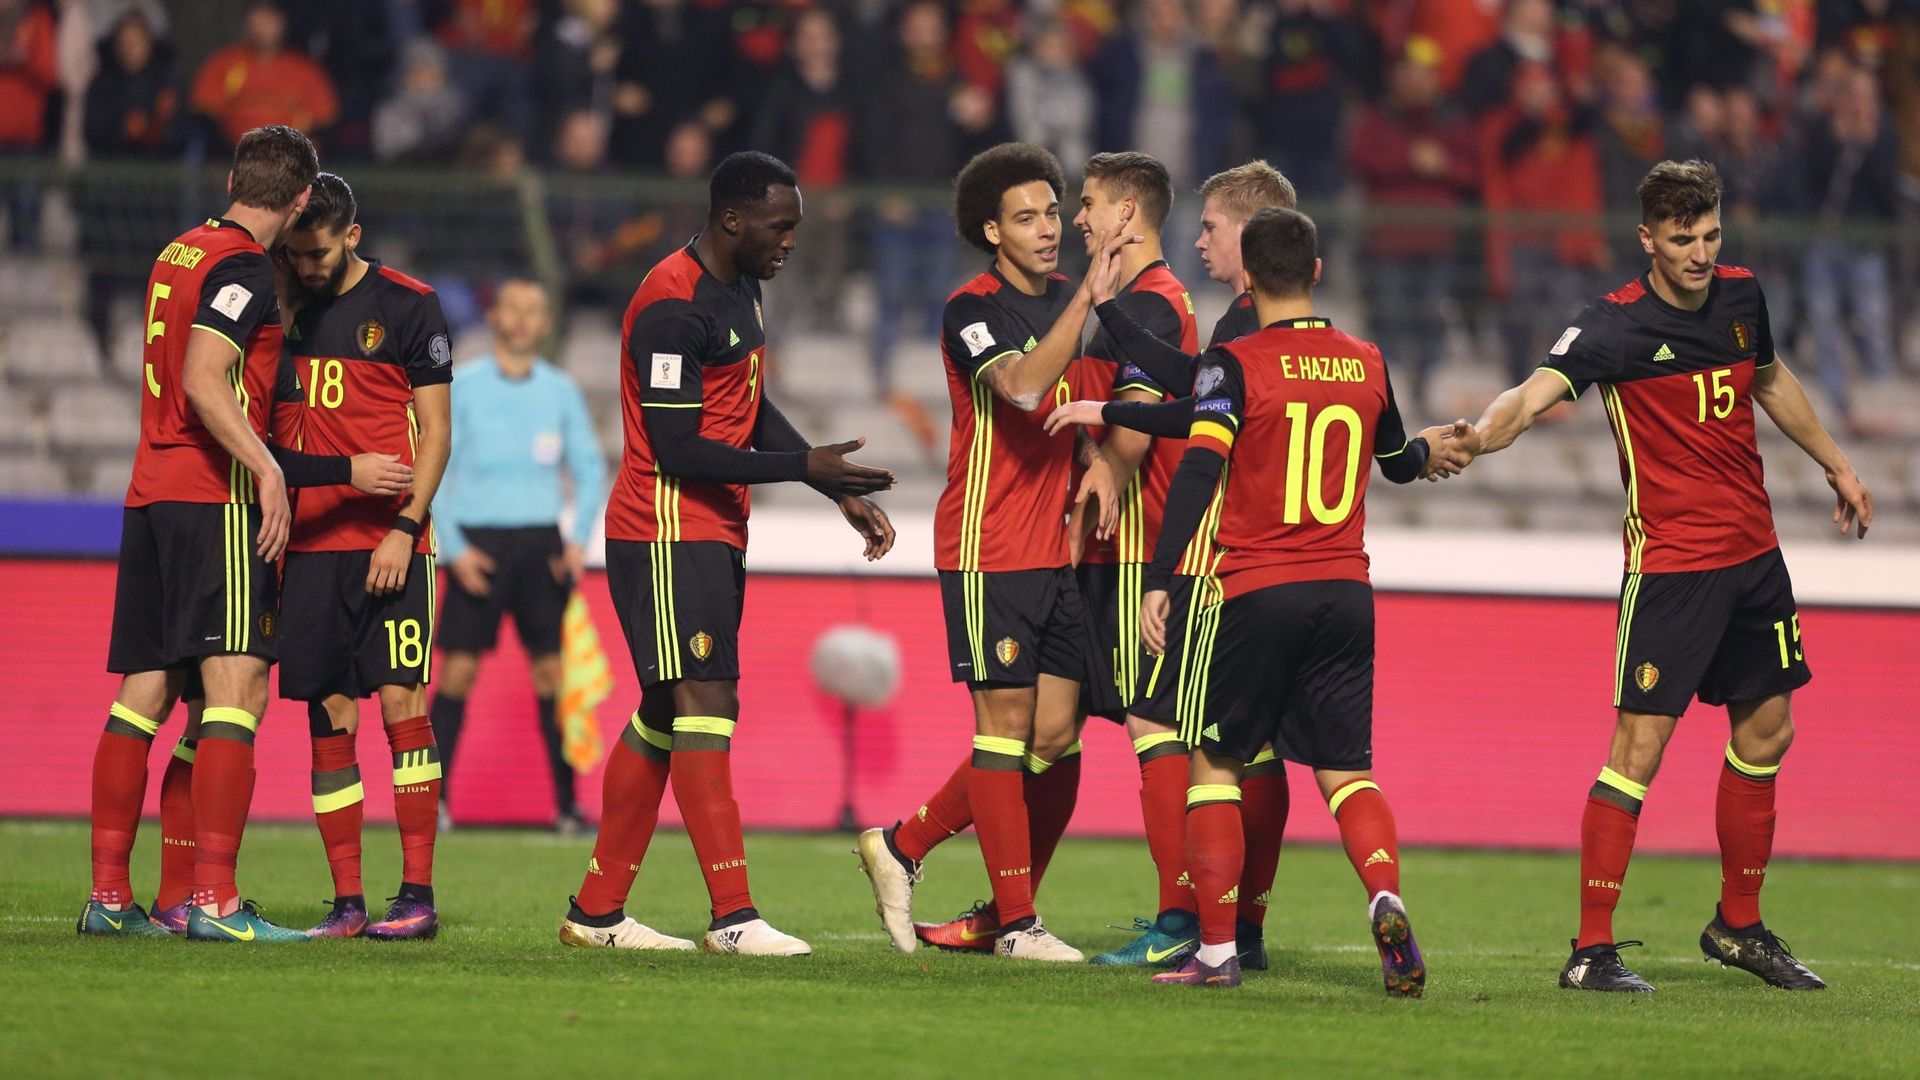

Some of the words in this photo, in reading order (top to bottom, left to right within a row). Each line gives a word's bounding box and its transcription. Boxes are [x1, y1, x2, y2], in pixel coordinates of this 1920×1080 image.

[146, 282, 171, 398] 5
[309, 359, 344, 409] 18
[749, 353, 759, 402] 9
[1280, 355, 1298, 379] E.
[1298, 356, 1366, 383] HAZARD
[1692, 369, 1735, 423] 15
[1283, 402, 1364, 525] 10
[385, 618, 423, 670] 18
